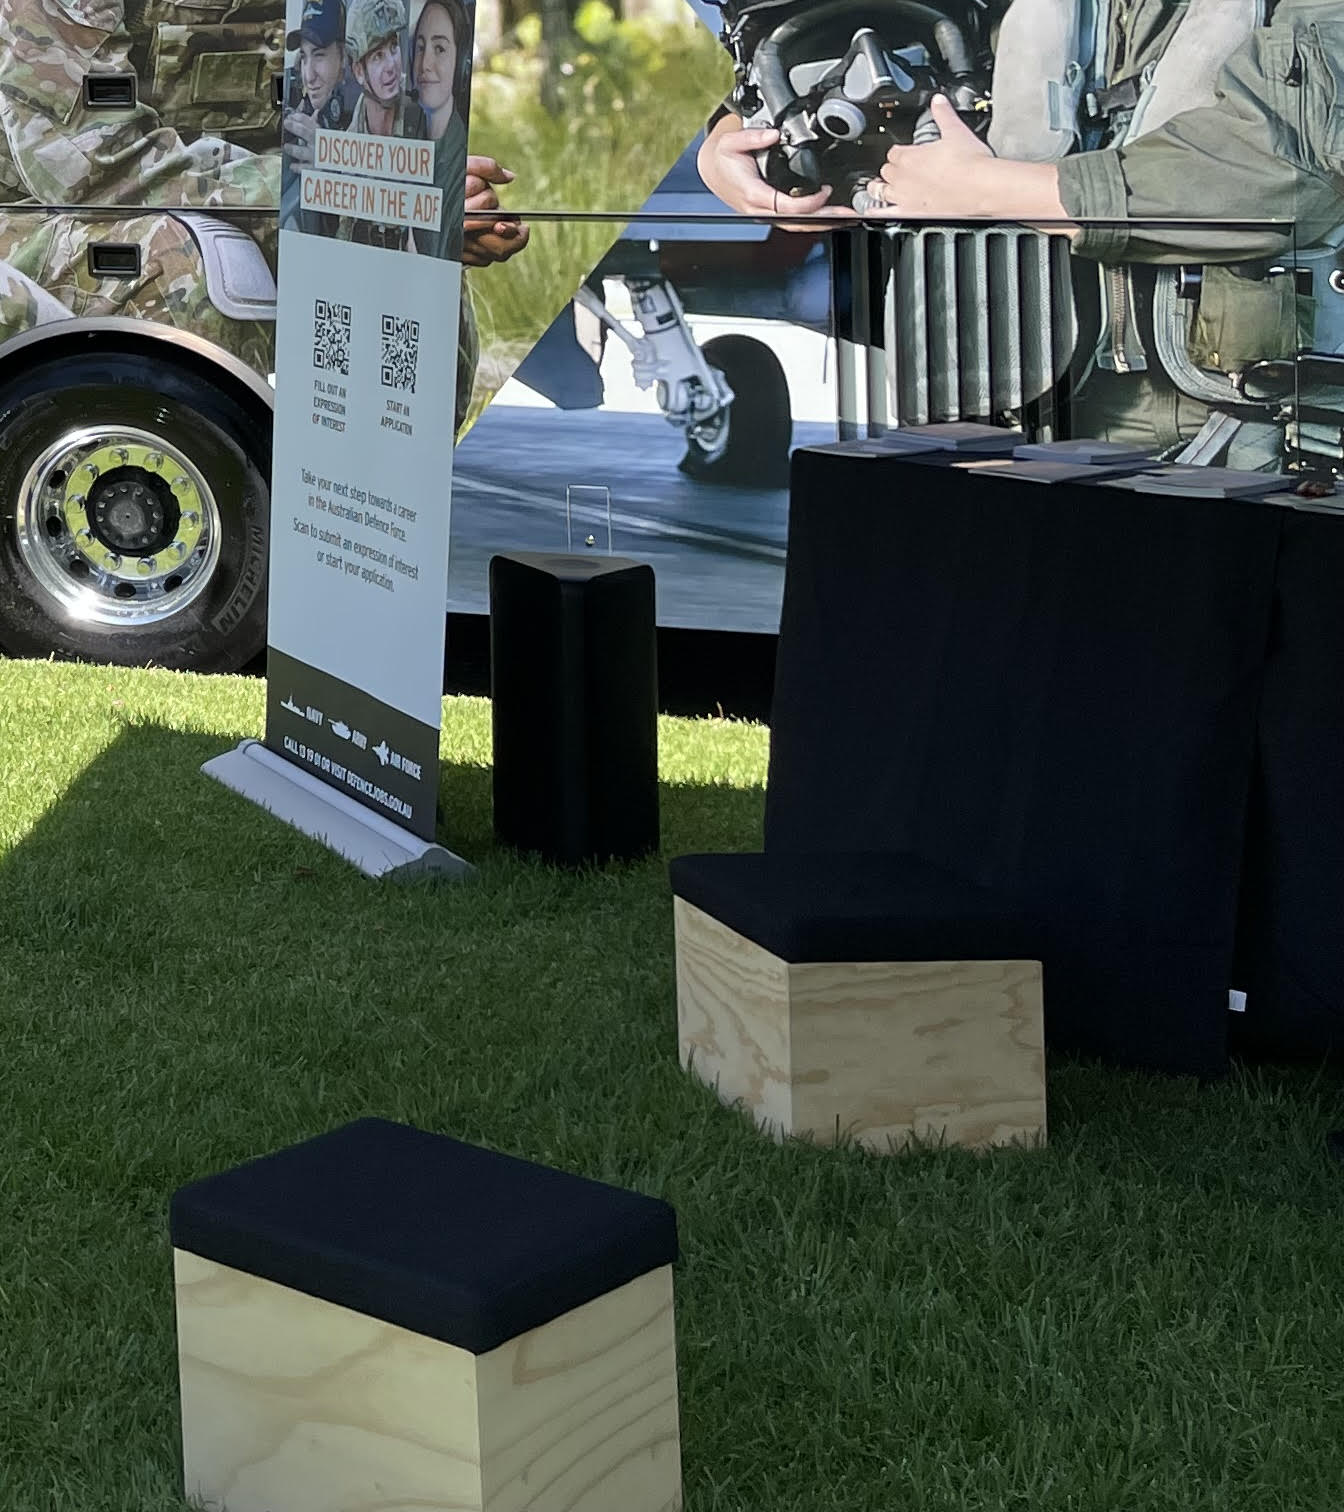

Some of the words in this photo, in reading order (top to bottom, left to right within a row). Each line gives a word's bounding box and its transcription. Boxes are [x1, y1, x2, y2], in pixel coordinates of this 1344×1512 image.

[319, 136, 384, 170] DISCOVER
[389, 140, 430, 177] YOUR
[304, 176, 358, 210] CAREER
[362, 187, 375, 212] IN
[380, 188, 408, 219] THE
[413, 195, 439, 223] ADF
[314, 380, 326, 394] FILL
[328, 383, 337, 396] OUT
[339, 388, 346, 398] AN
[313, 396, 346, 416] EXPRESSION
[386, 400, 402, 414] START
[404, 405, 410, 416] AN
[312, 413, 320, 424] OF
[321, 415, 346, 432] INTEREST
[380, 416, 413, 435] APPLICATION
[301, 468, 316, 486] Take
[318, 478, 332, 491] your
[333, 482, 348, 497] next
[350, 488, 366, 504] step
[368, 491, 392, 513] towards
[398, 505, 417, 522] career
[308, 495, 314, 507] in
[316, 495, 326, 512] the
[328, 500, 363, 524] Australian
[364, 511, 389, 534] Defence
[293, 517, 309, 534] Scan
[311, 523, 318, 538] to
[319, 527, 341, 547] submit
[343, 538, 352, 551] an
[353, 542, 387, 565] expression
[388, 553, 395, 568] of
[395, 557, 418, 580] interest
[317, 550, 324, 562] or
[326, 552, 342, 569] start
[344, 560, 360, 576] your
[218, 525, 263, 632] MICHELIN
[306, 706, 323, 726] NAVY
[352, 730, 367, 750] ARMY
[284, 736, 299, 755] CALL
[299, 744, 306, 759] 13
[307, 748, 313, 763] 19
[322, 756, 330, 773] OR
[331, 761, 347, 782] VISIT
[390, 751, 401, 770] AIR
[401, 757, 422, 781] FORCE
